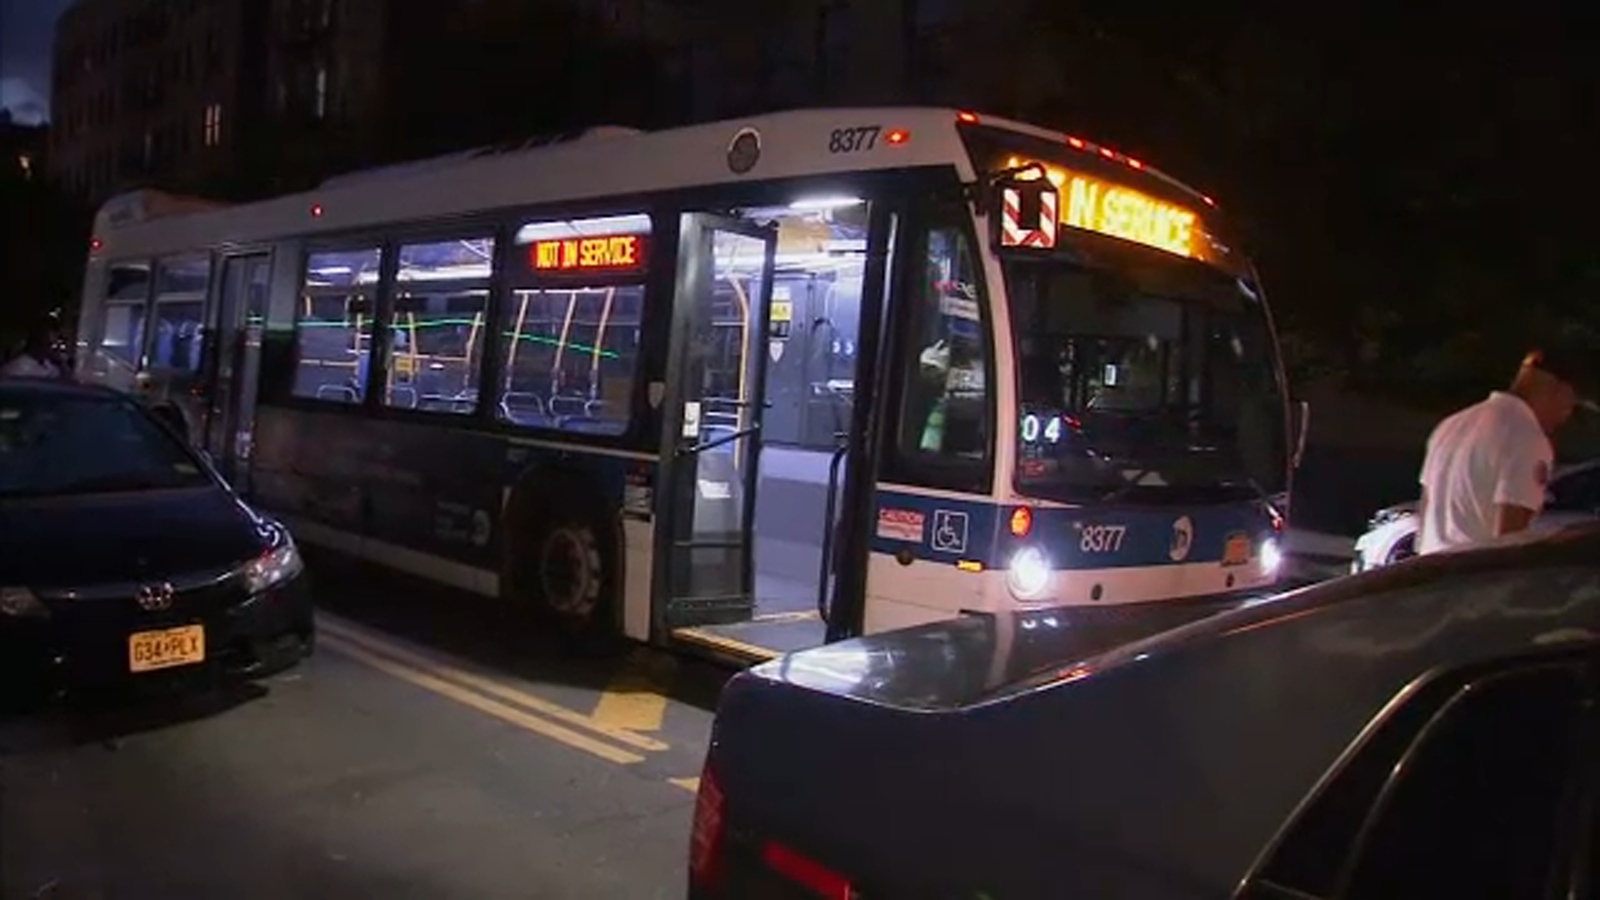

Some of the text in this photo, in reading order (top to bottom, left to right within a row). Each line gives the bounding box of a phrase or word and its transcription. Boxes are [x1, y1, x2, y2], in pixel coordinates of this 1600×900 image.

[829, 126, 881, 153] 8377
[1102, 186, 1195, 258] SERVICE
[537, 236, 636, 268] NOT IN SERVICE
[1080, 525, 1126, 552] 8377
